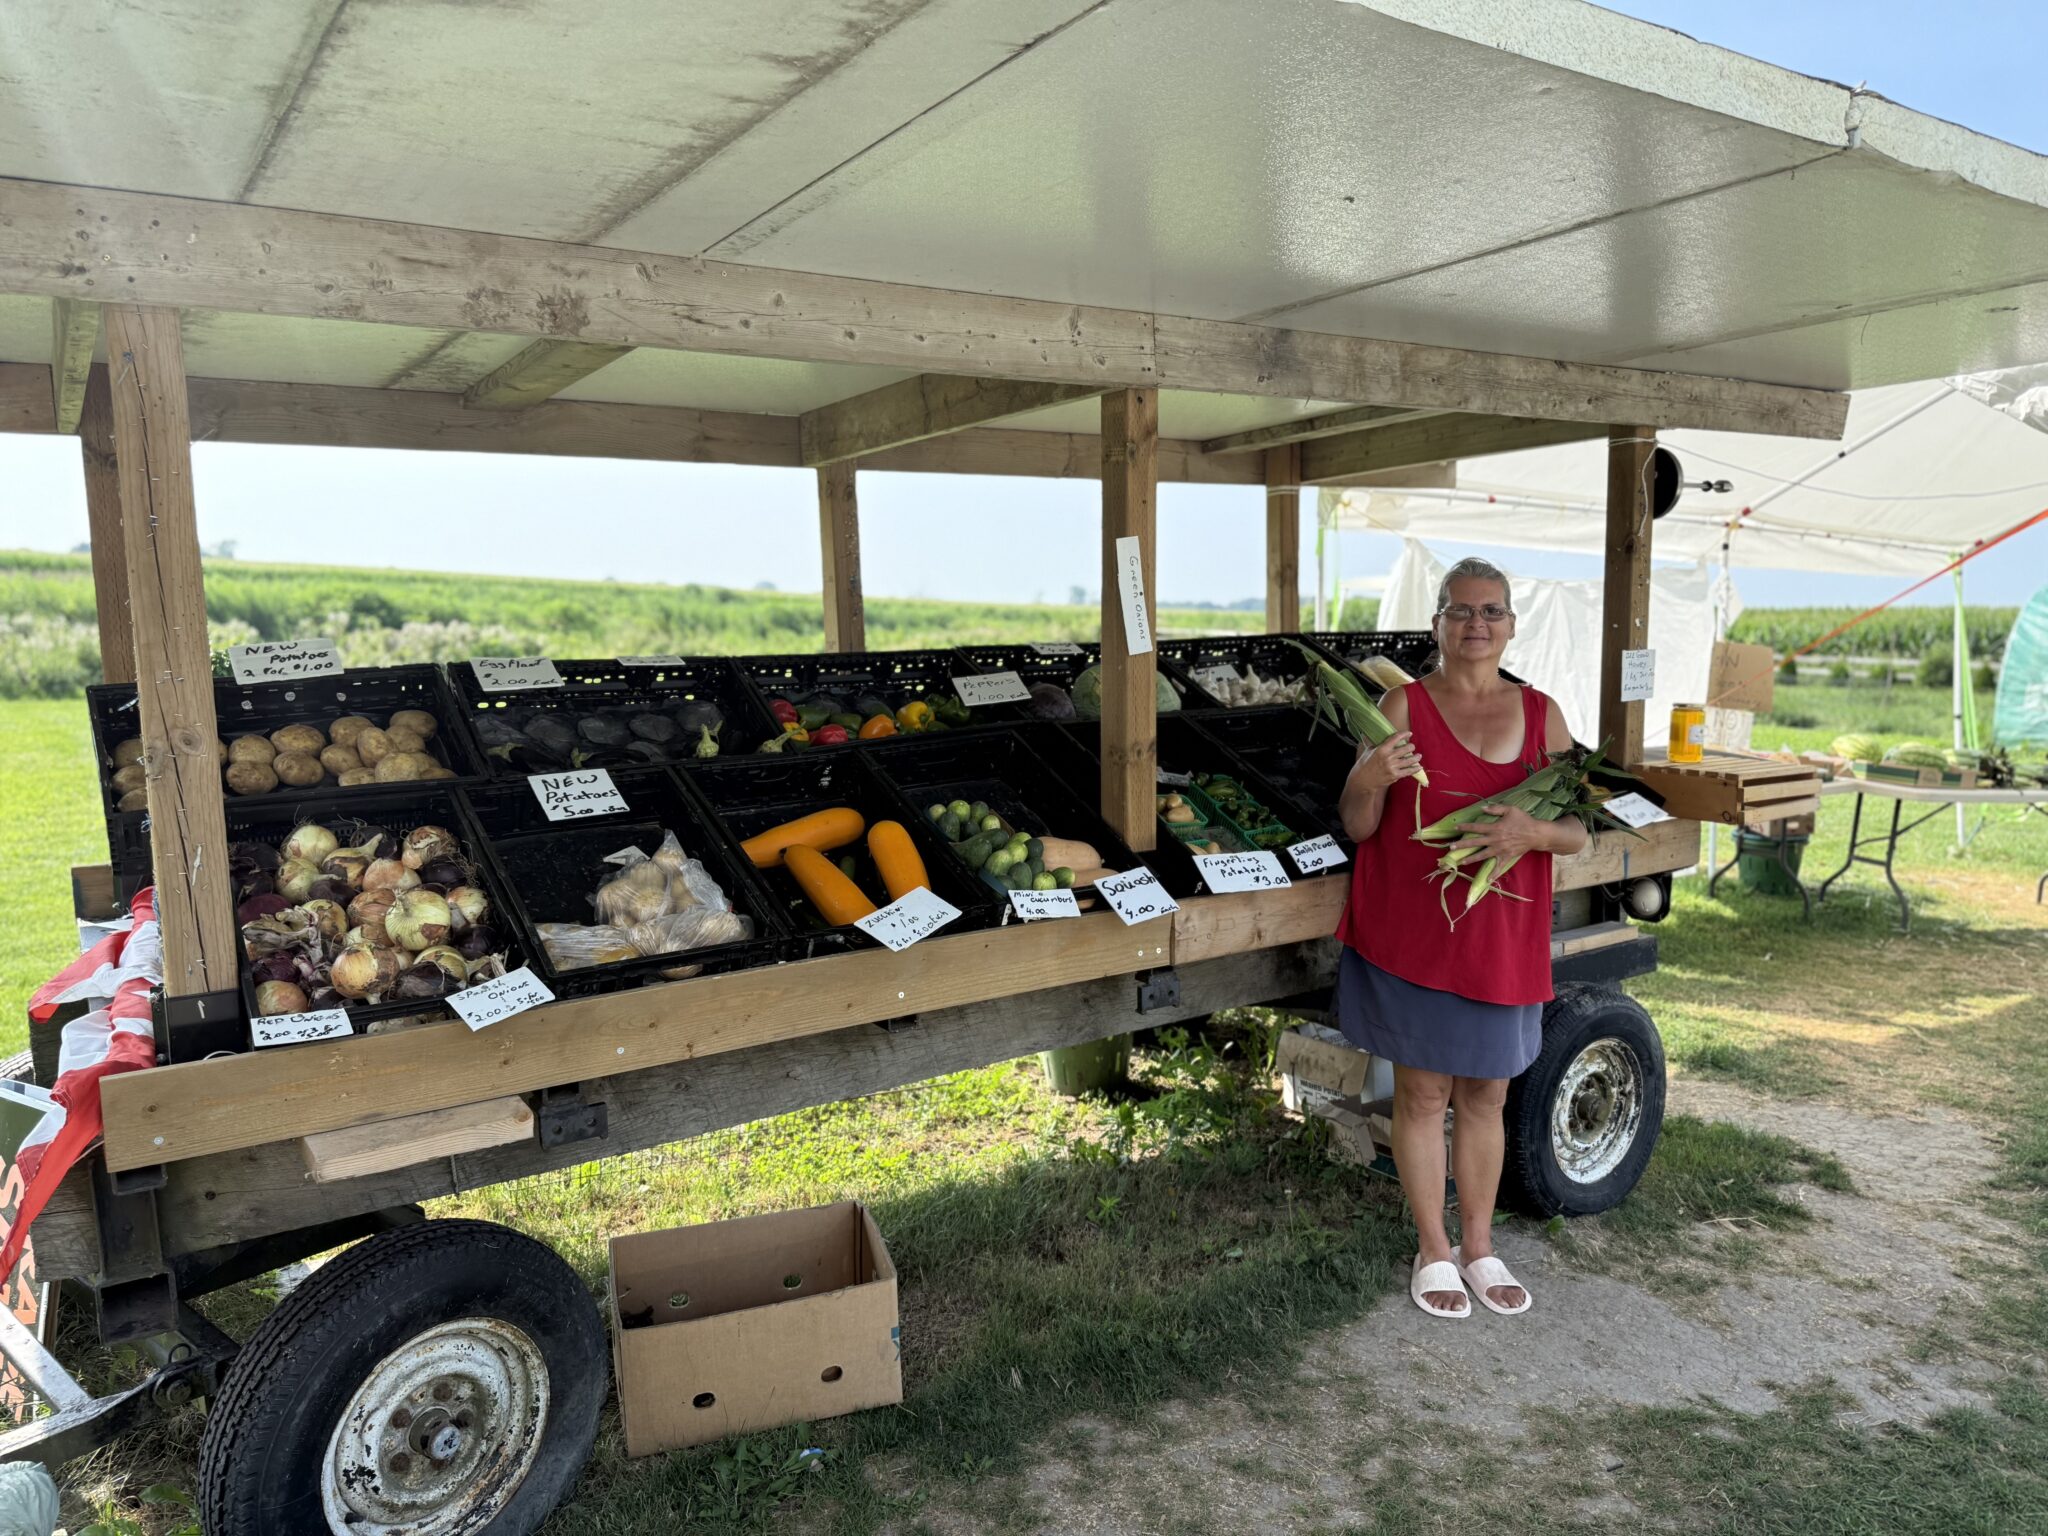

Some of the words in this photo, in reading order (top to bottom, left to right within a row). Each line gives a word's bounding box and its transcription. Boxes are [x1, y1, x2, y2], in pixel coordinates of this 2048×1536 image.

[246, 642, 298, 655] NEW
[541, 775, 598, 792] NEW
[545, 789, 619, 804] Potatoes
[1101, 872, 1156, 897] Squash
[1253, 876, 1288, 886] $3.00
[1116, 900, 1155, 920] $4.00
